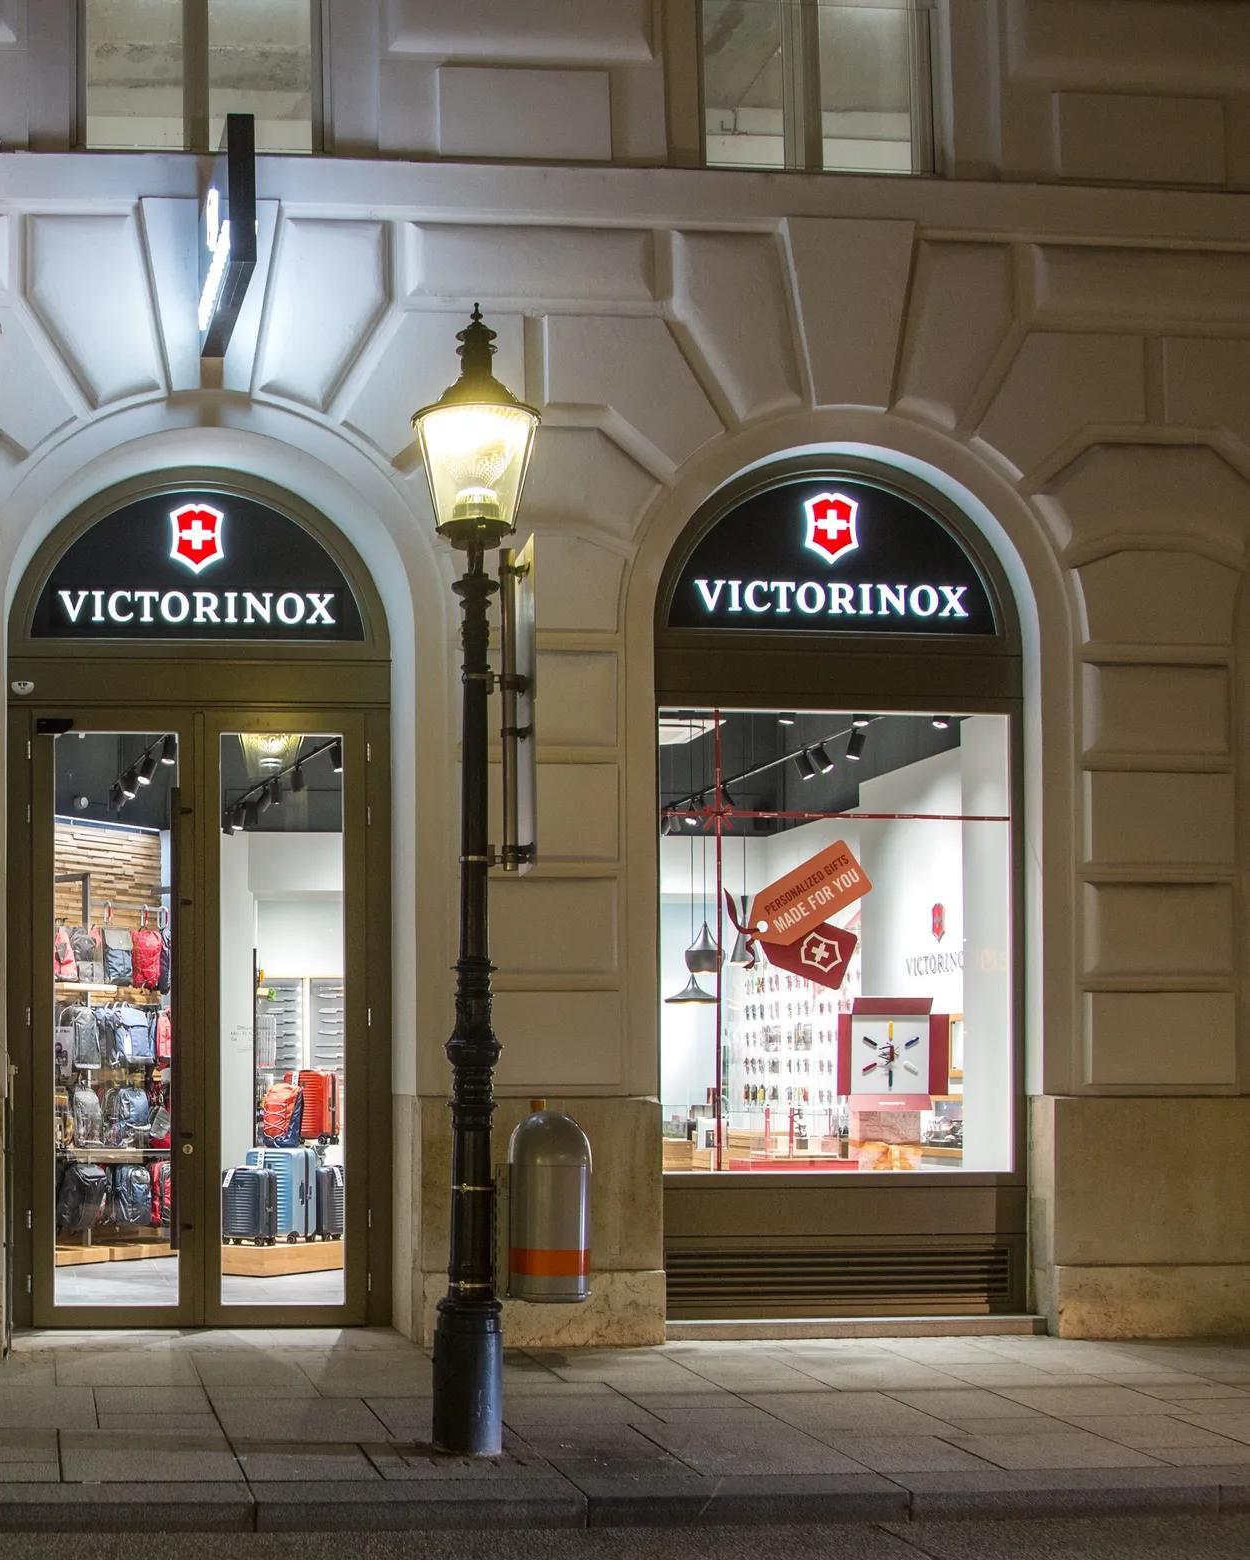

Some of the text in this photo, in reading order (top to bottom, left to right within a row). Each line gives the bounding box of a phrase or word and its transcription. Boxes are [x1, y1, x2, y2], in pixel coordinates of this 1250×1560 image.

[58, 589, 336, 625] VICTORINOX
[694, 578, 969, 617] VICTORINOX
[764, 854, 850, 915] PERSONALIZED GIFTS
[772, 868, 861, 934] MADE FOR YOU
[905, 950, 964, 977] VICTORINO
